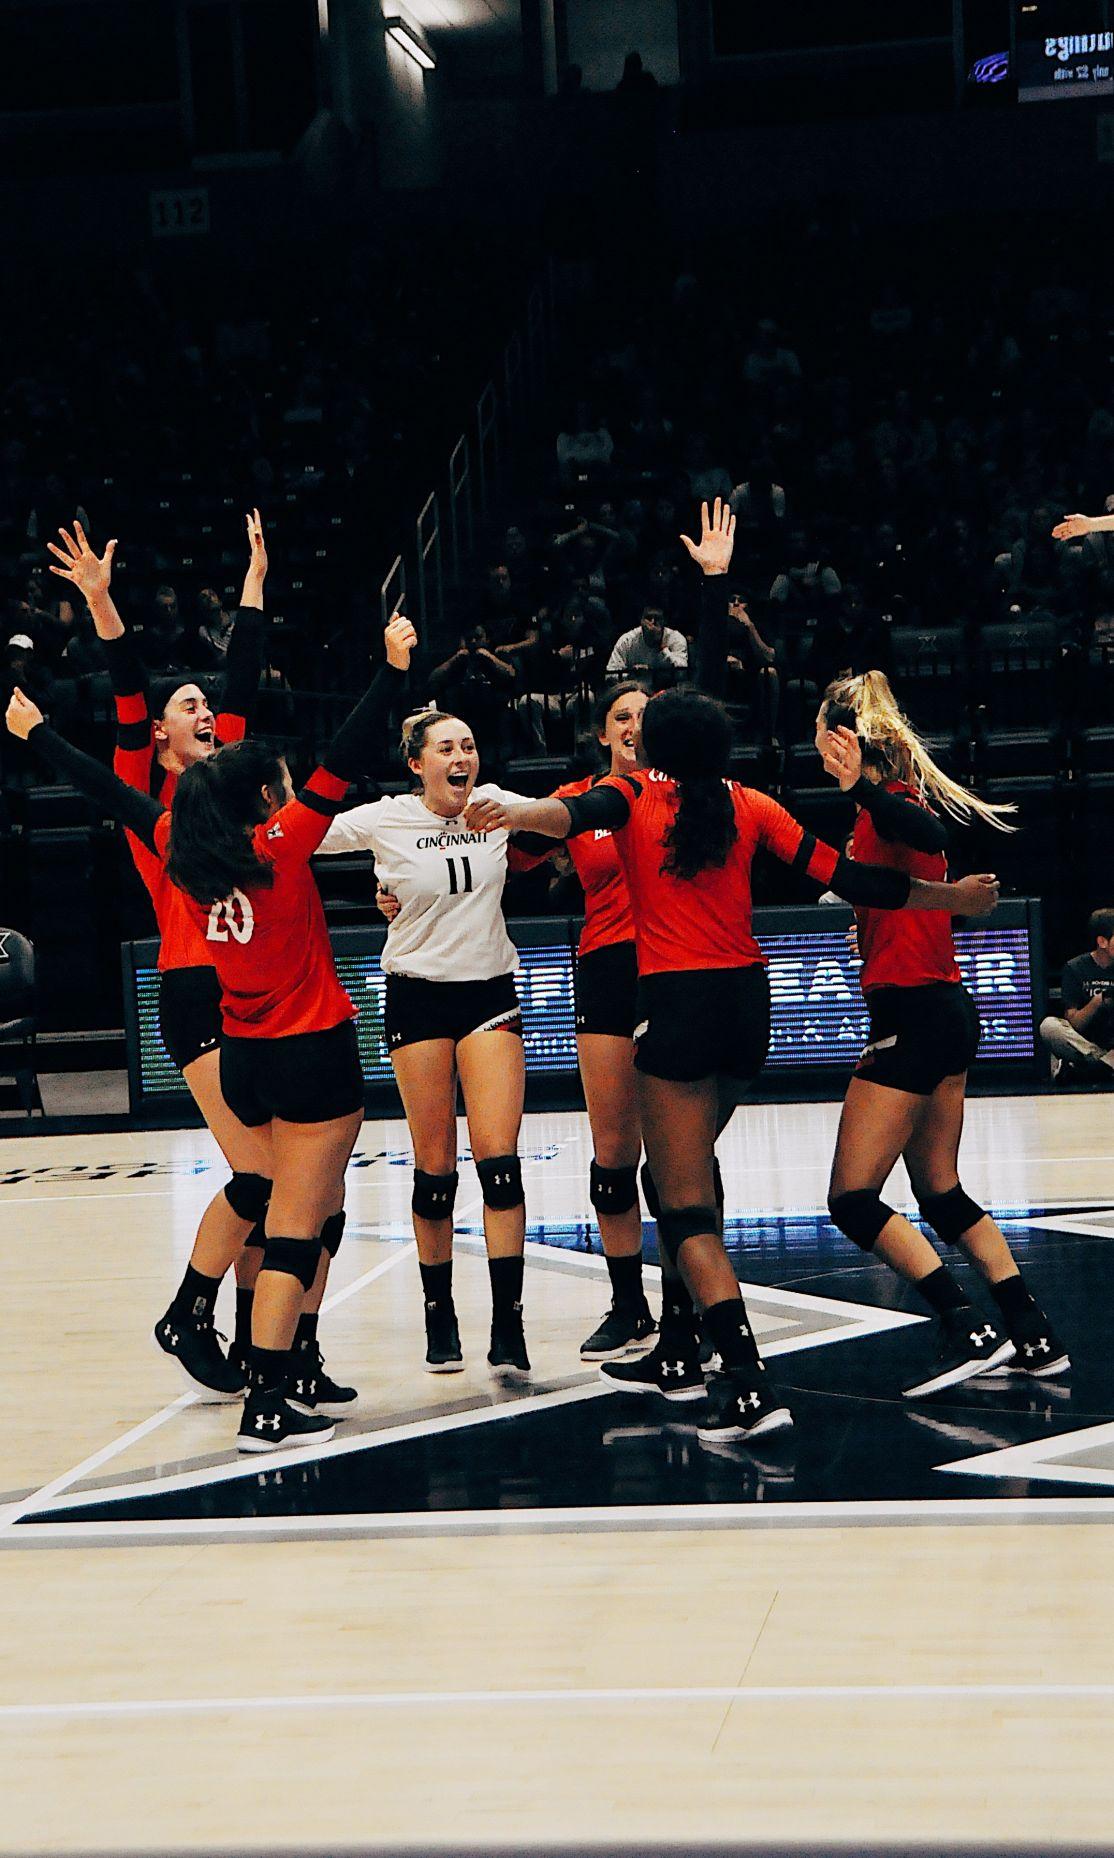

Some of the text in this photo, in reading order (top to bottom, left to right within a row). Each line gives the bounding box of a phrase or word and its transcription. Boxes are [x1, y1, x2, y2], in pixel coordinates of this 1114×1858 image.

[157, 197, 203, 226] 112
[416, 831, 487, 850] CINCINNATI
[445, 855, 473, 895] 11
[206, 887, 254, 944] 20
